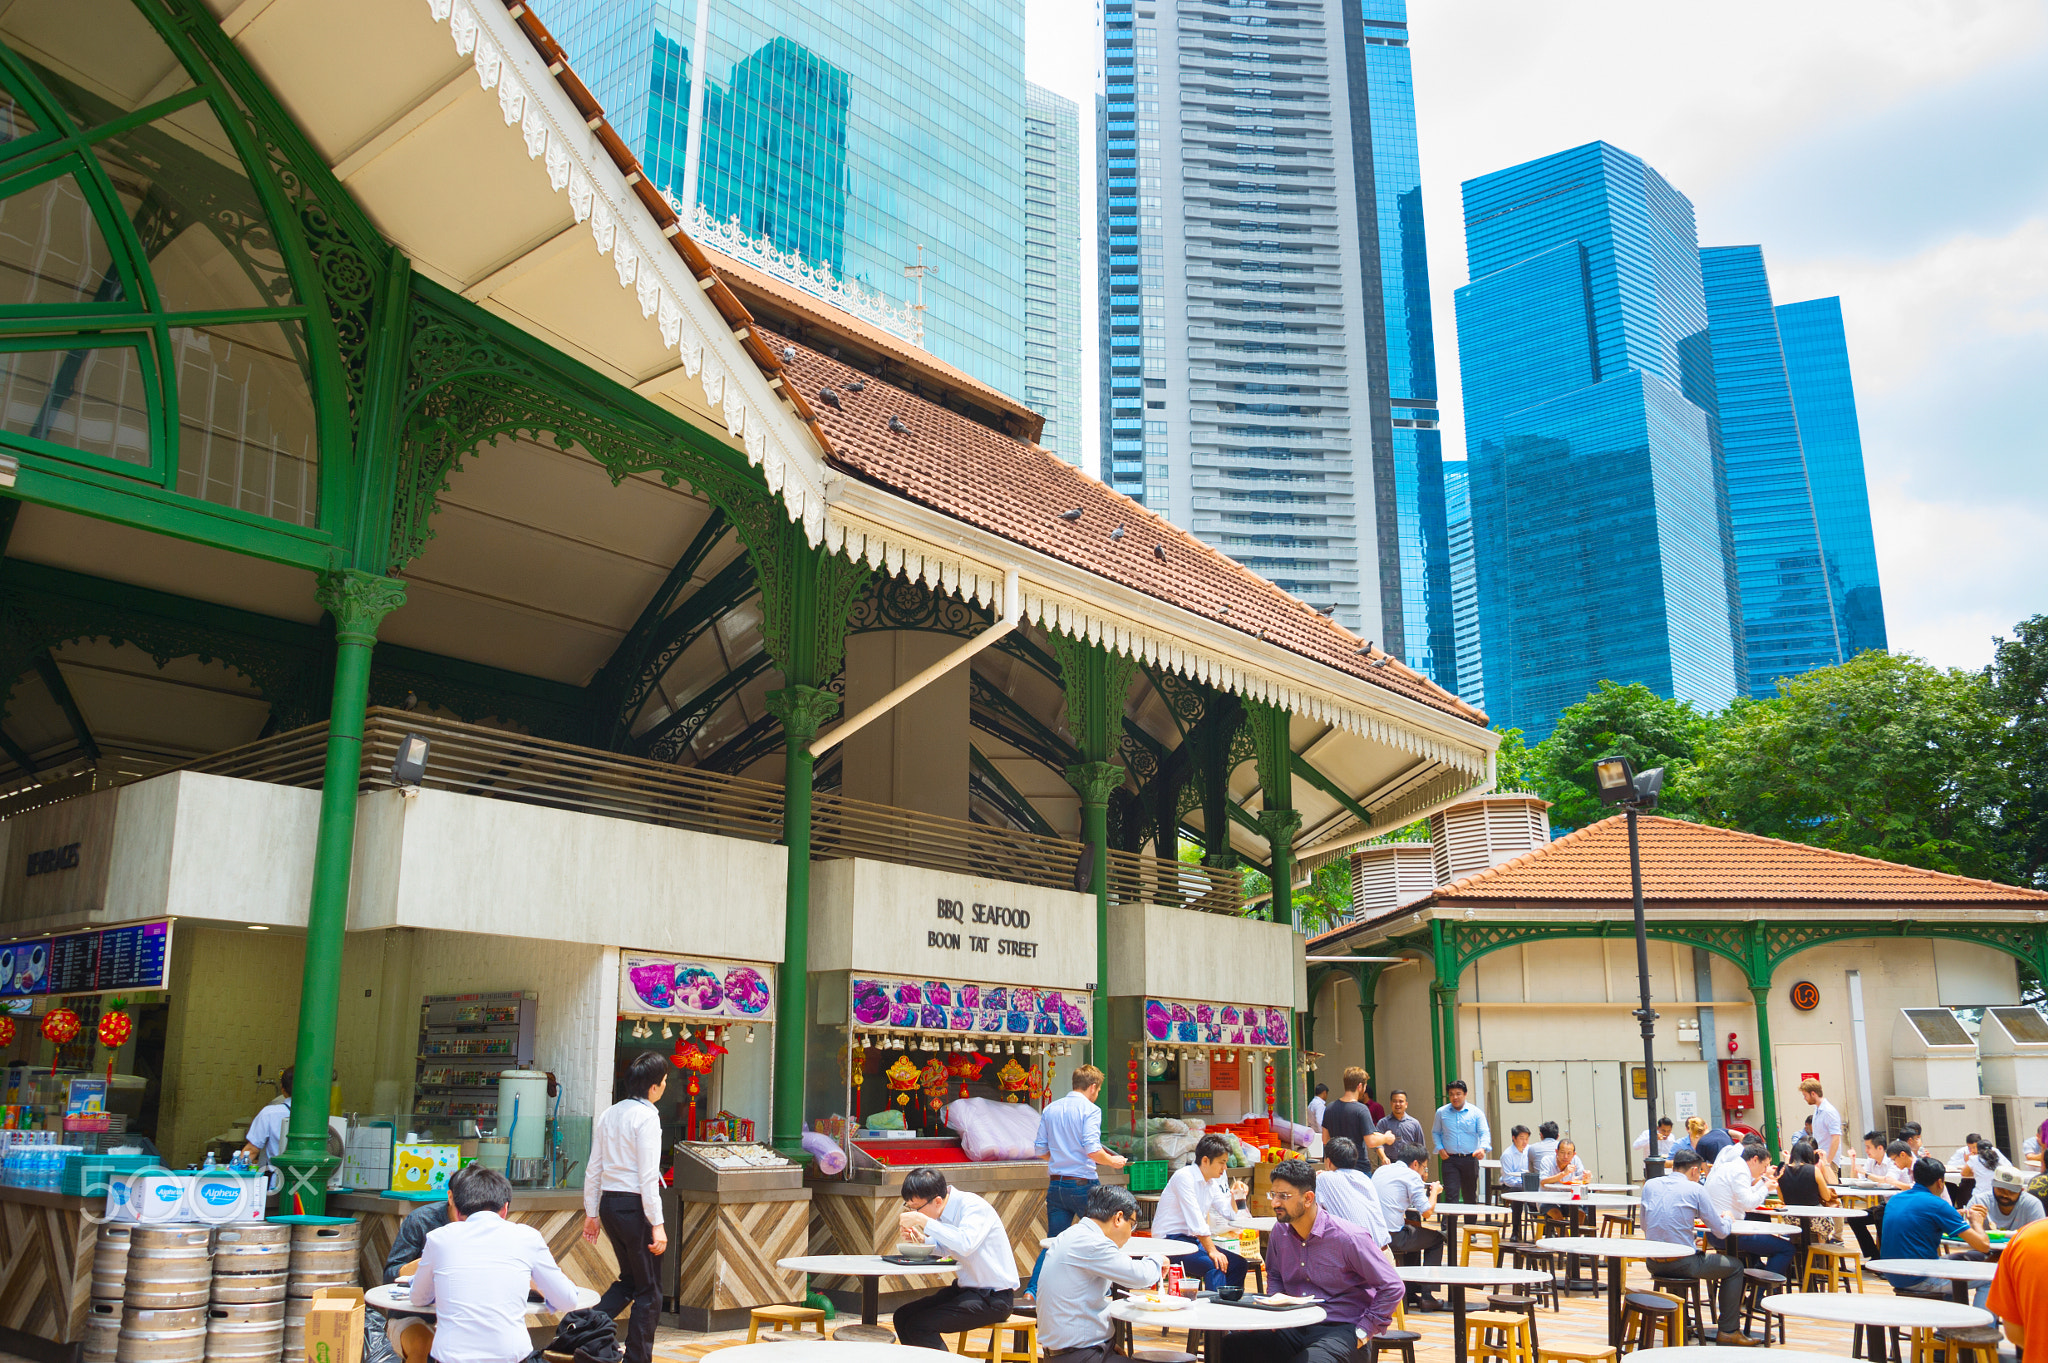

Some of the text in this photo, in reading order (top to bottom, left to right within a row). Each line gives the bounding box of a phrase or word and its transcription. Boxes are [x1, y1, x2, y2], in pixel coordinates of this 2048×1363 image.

[937, 898, 1030, 929] BBQ SEAFOOD
[928, 930, 1038, 958] BOON TAT STREET
[205, 1188, 239, 1201] Alpheus
